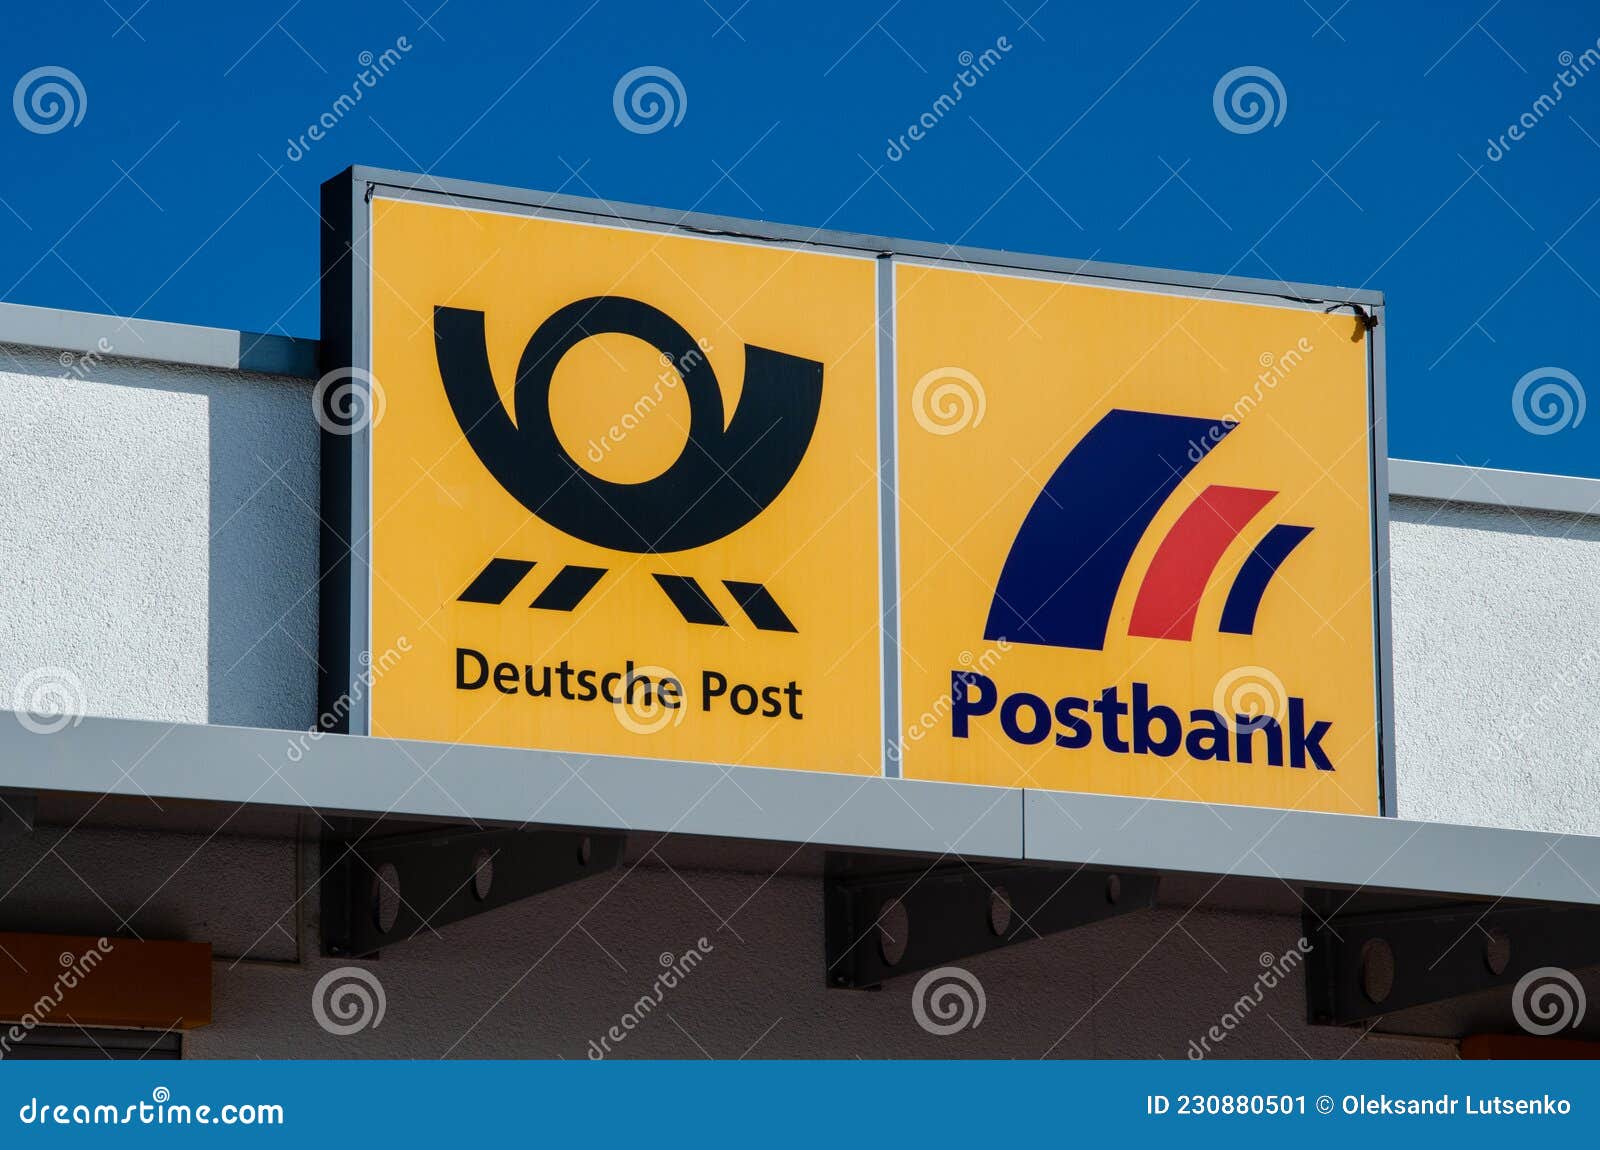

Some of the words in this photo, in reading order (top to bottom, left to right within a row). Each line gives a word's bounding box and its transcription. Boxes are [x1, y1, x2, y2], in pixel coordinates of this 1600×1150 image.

[456, 648, 683, 709] Deutsche
[702, 670, 804, 720] Post
[951, 670, 1336, 772] Postbank
